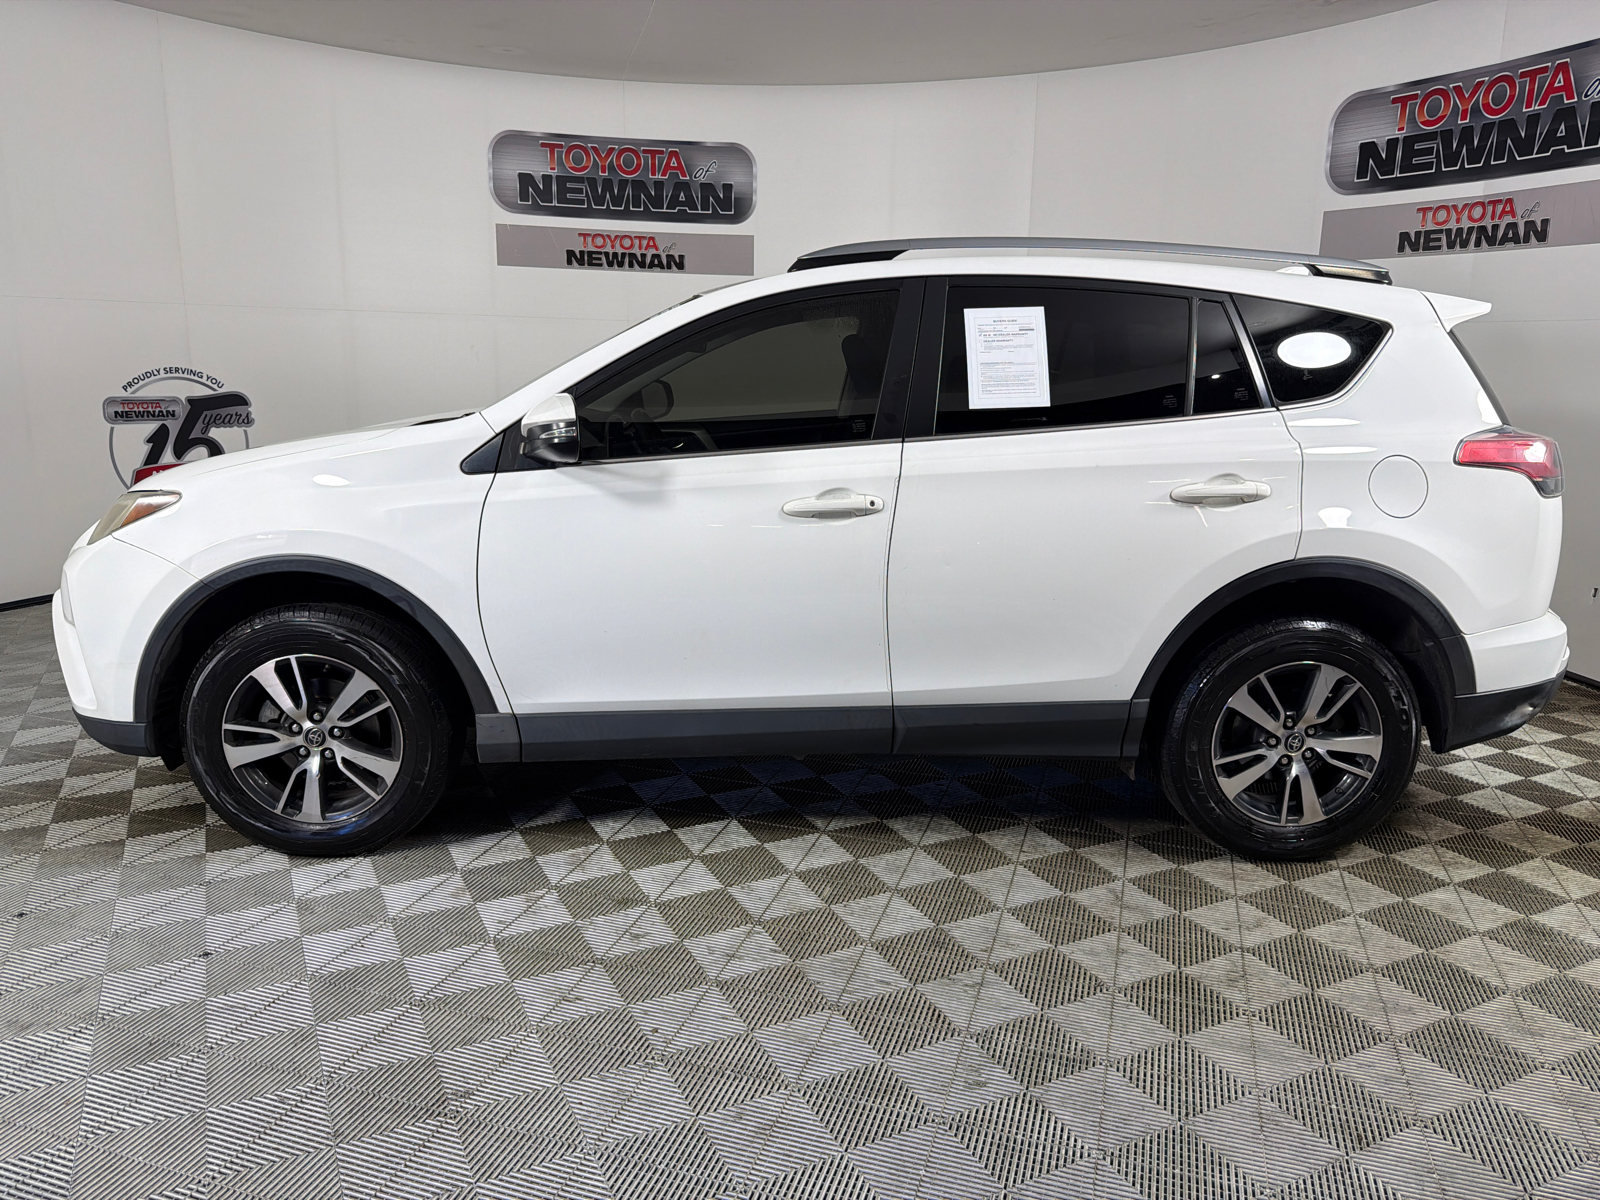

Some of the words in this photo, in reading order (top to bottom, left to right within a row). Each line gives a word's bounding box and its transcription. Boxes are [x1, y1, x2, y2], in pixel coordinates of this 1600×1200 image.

[1391, 58, 1577, 133] TOYOTA
[1582, 77, 1600, 100] o
[539, 141, 689, 180] TOYOTA
[692, 160, 717, 181] of
[517, 172, 735, 214] NEWNAN
[1416, 197, 1517, 228] TOYOTA
[1521, 201, 1540, 219] of
[578, 232, 659, 252] TOYOTA
[662, 242, 676, 253] of
[1397, 217, 1550, 254] NEWNAN
[565, 249, 686, 271] NEWNAN
[121, 368, 161, 393] PROUDLY
[163, 366, 203, 379] SERVING
[205, 374, 225, 389] YOU
[114, 410, 176, 419] NEWNAN
[120, 402, 162, 410] TOYOTA
[144, 393, 250, 467] 15
[200, 410, 252, 435] years
